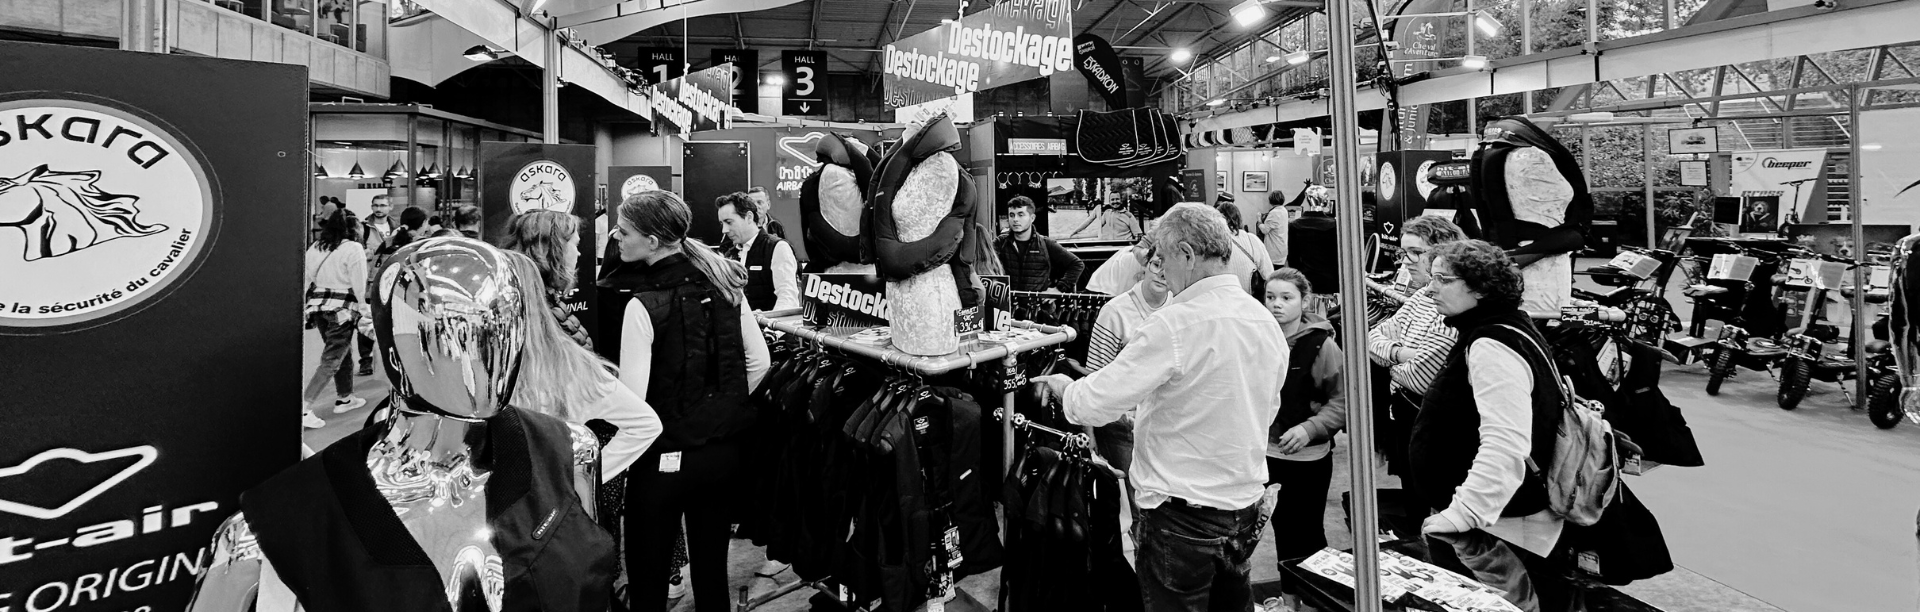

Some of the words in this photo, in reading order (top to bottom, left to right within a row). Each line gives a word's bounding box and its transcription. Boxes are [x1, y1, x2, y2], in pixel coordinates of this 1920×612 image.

[948, 21, 1072, 76] Destockage
[1412, 41, 1437, 51] Cheval
[652, 53, 674, 61] HALL
[794, 55, 815, 64] HALL
[653, 64, 668, 83] 1
[884, 44, 980, 95] Destockage
[1083, 55, 1119, 94] ESKADRON
[796, 66, 815, 96] 3
[651, 84, 692, 134] Destockage
[520, 164, 567, 183] askara
[1767, 159, 1812, 170] beeper
[627, 176, 654, 186] askara
[11, 302, 31, 314] la
[38, 288, 123, 314] sécurité
[126, 276, 149, 293] du
[149, 228, 192, 278] cavalier
